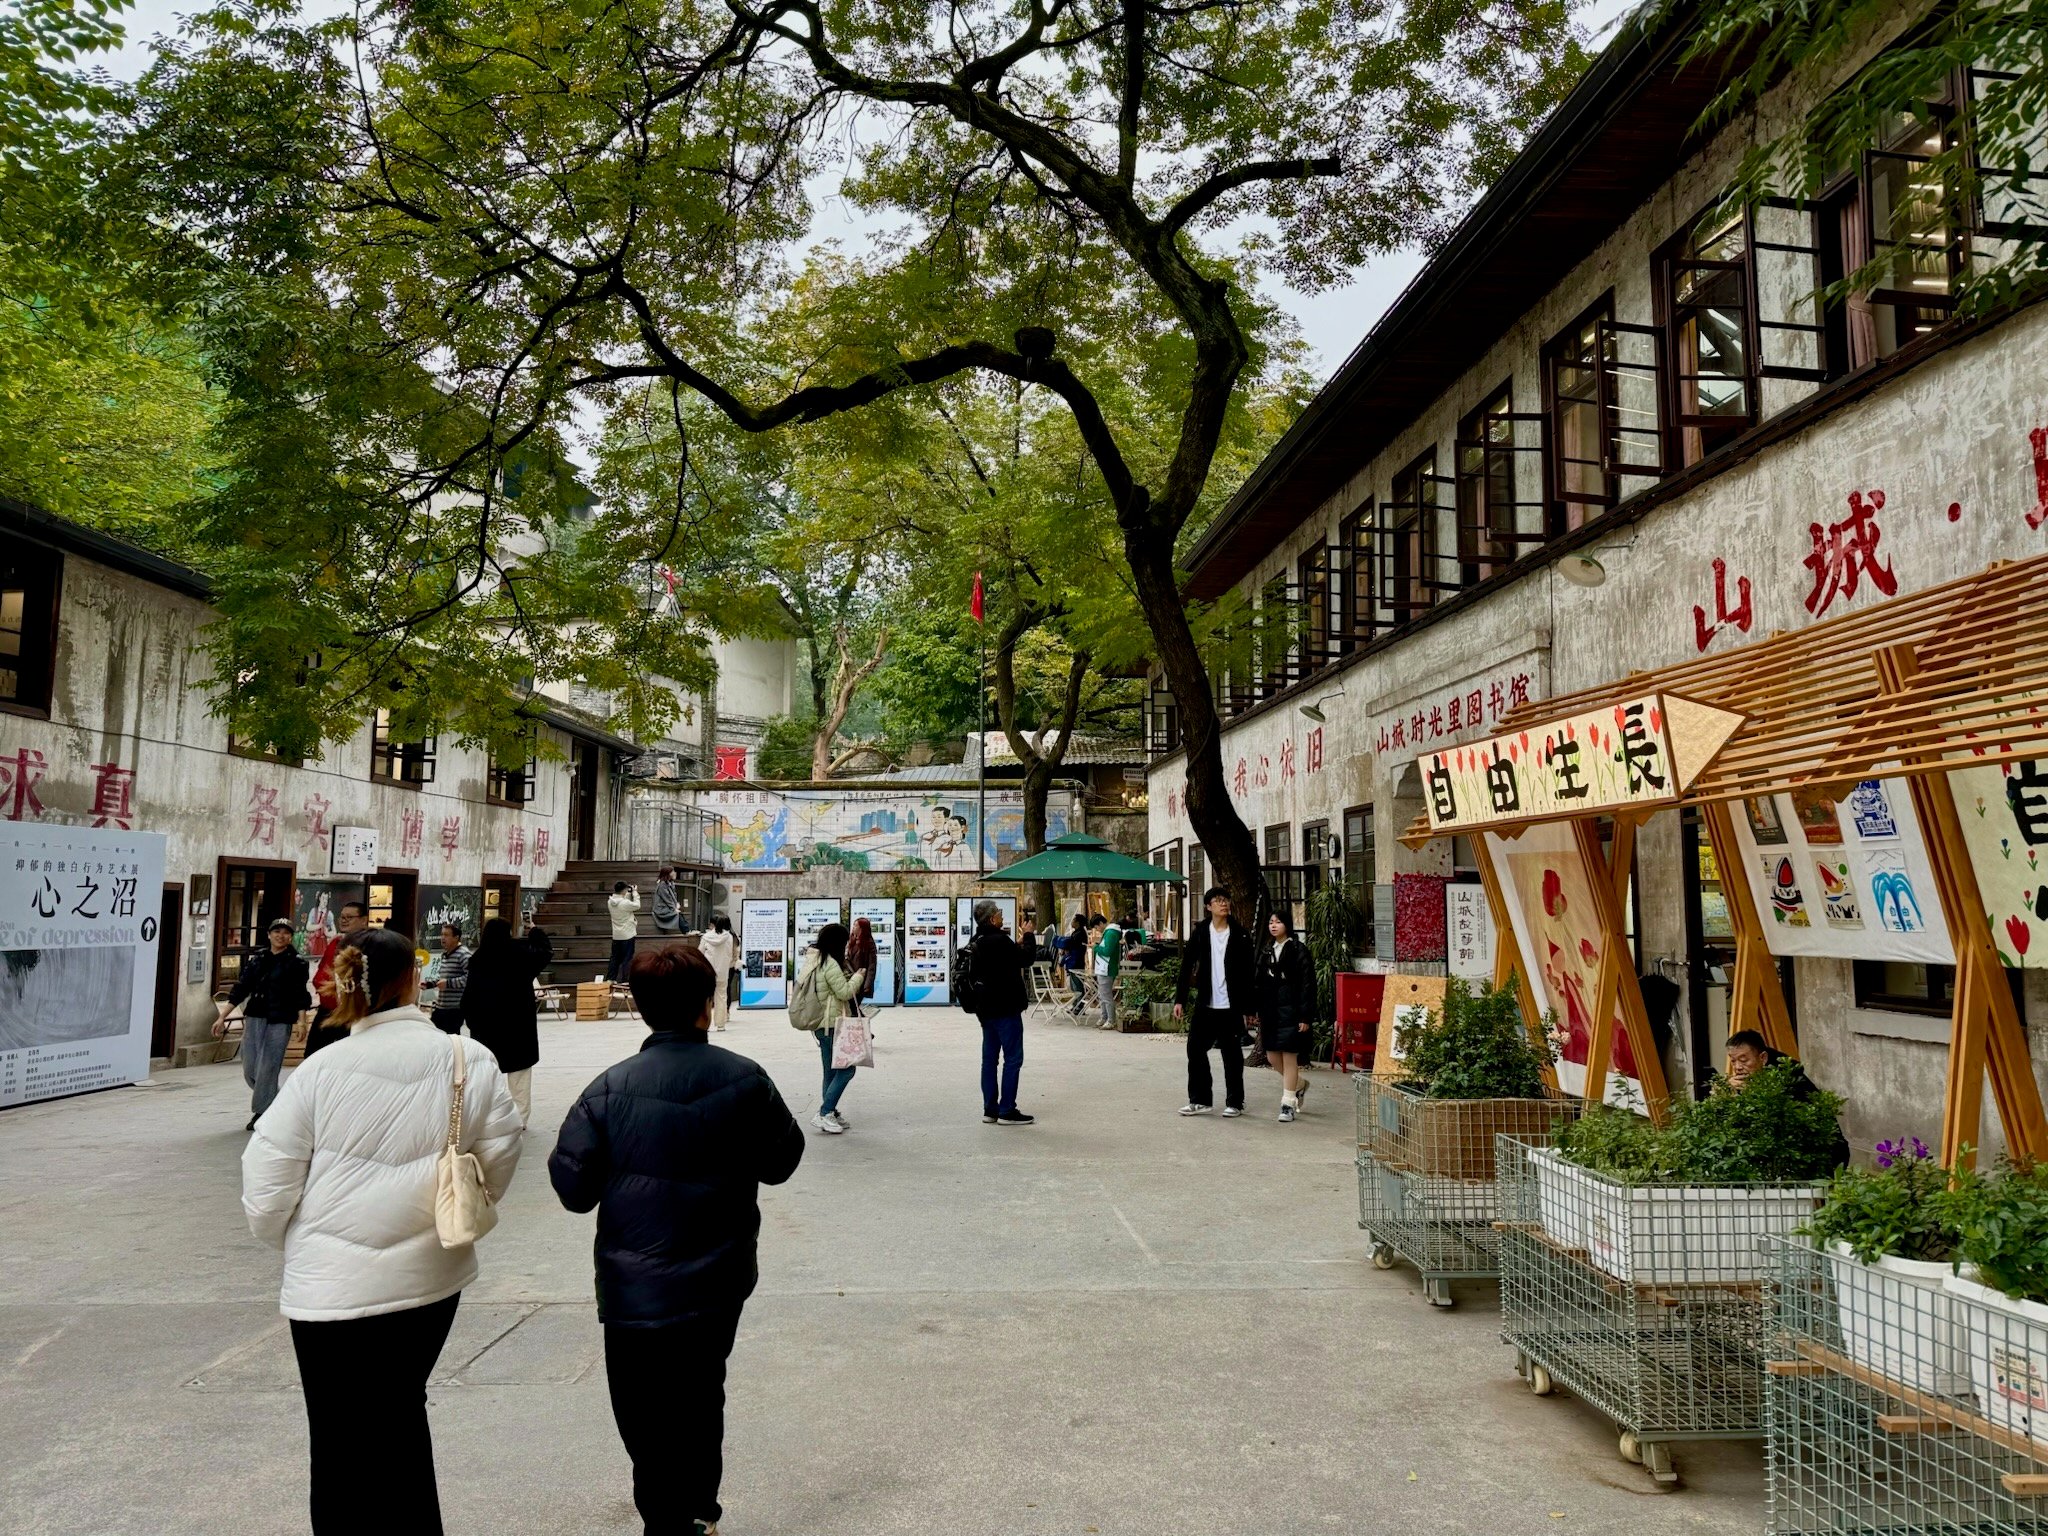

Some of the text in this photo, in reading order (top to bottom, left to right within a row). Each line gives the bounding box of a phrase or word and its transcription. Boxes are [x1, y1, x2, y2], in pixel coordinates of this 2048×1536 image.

[0, 748, 136, 830] 求真
[247, 783, 331, 851] 务实
[401, 807, 461, 862] 博学
[508, 824, 549, 867] 精思
[719, 792, 769, 804] 胸怀祖国
[15, 858, 139, 876] 抑郁的独白行为艺术展
[31, 875, 137, 919] 心之沼
[14, 926, 37, 947] of
[41, 925, 135, 949] depression
